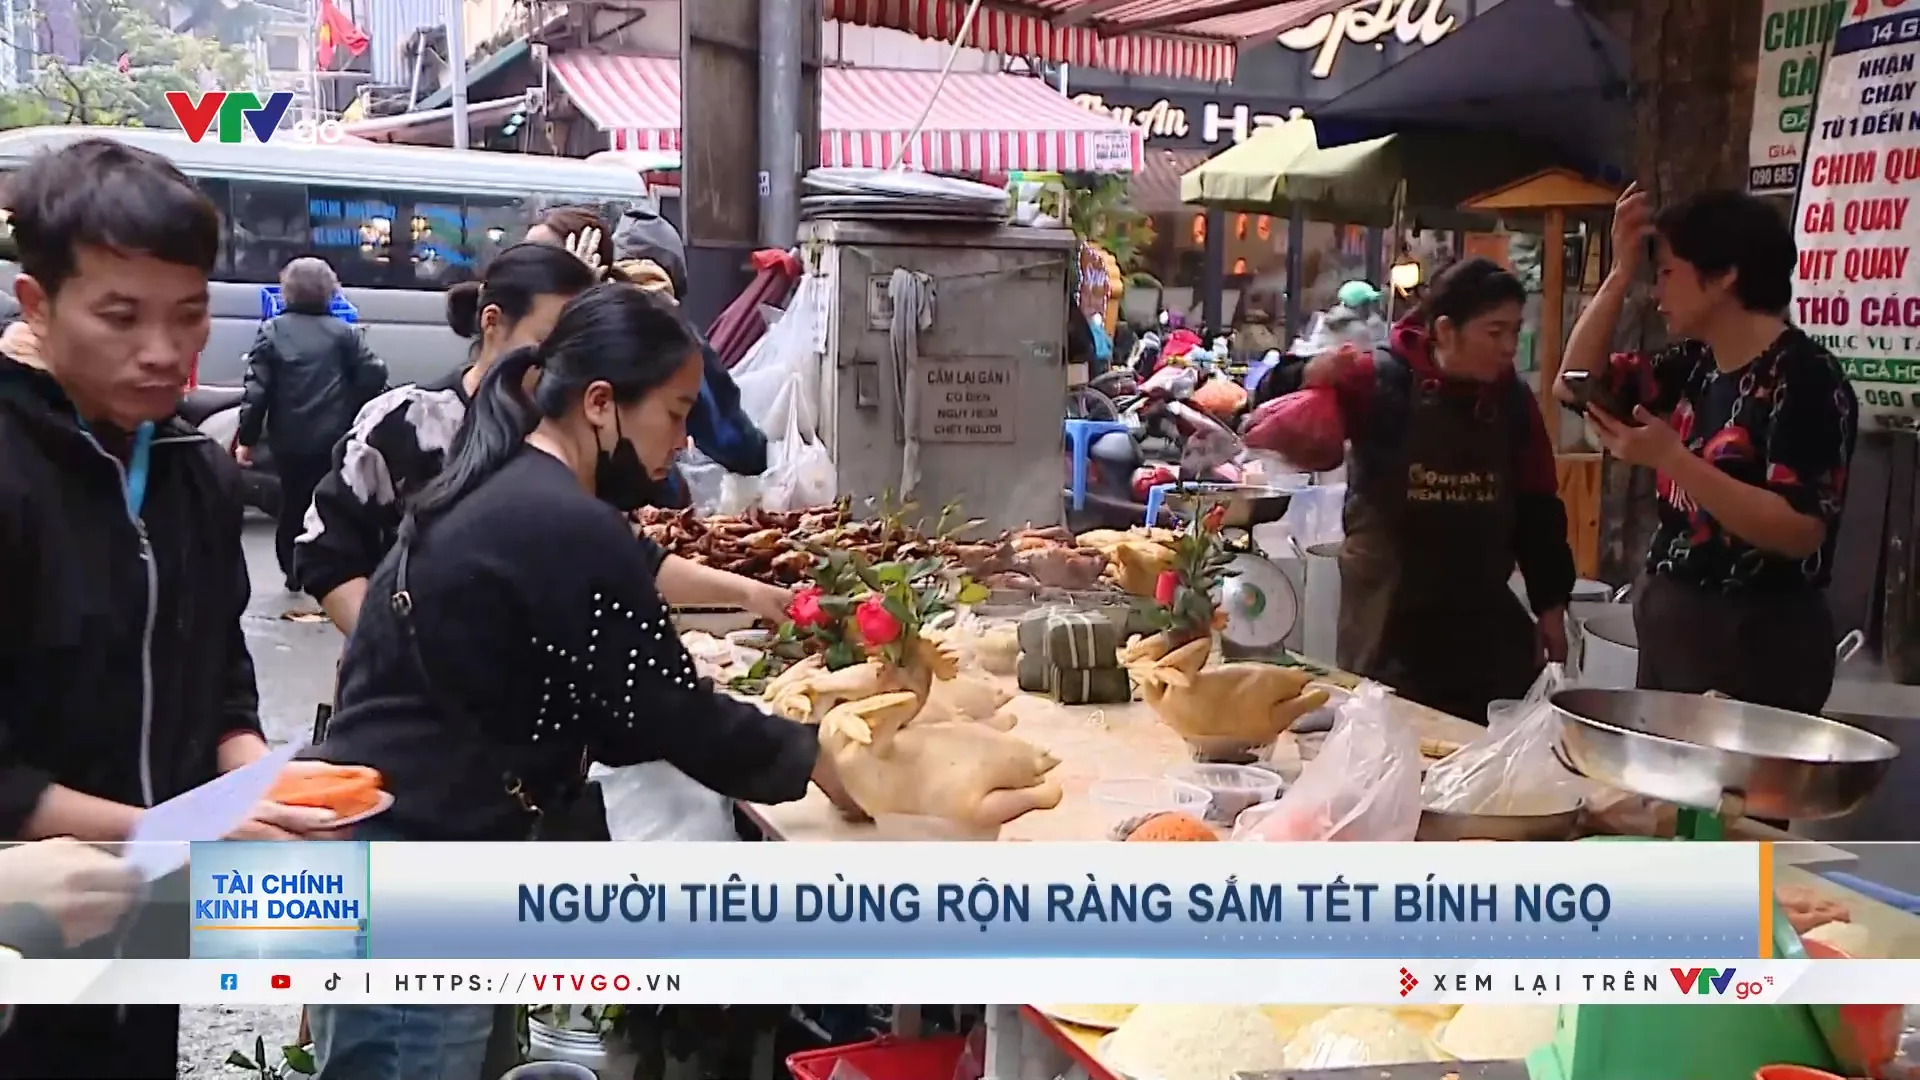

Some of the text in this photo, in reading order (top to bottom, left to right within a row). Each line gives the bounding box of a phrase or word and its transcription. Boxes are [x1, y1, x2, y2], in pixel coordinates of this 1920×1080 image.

[1871, 17, 1920, 44] 14 G
[1849, 117, 1859, 137] 1
[1811, 150, 1879, 187] CHIM
[1804, 197, 1910, 235] GÀ QUAY
[1799, 246, 1910, 286] VỊT QUAY
[1796, 289, 1850, 326] THỎ
